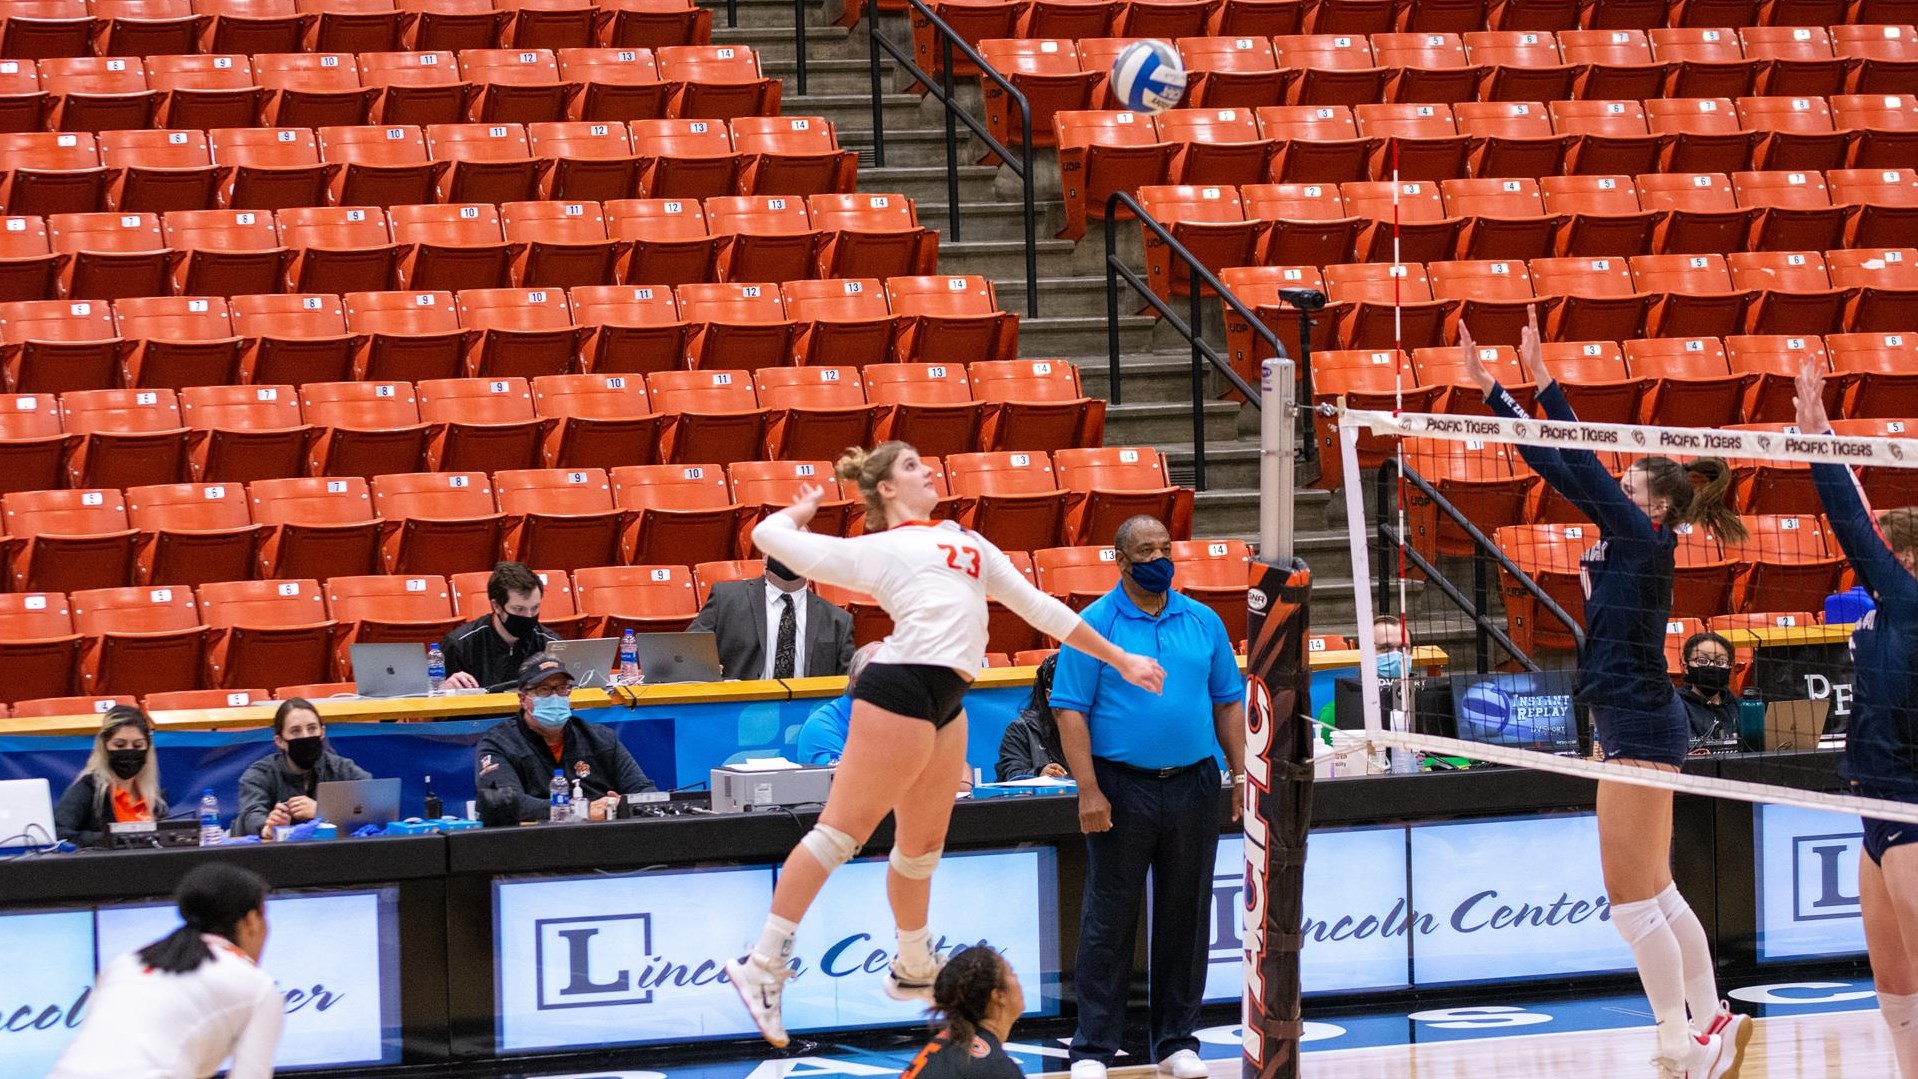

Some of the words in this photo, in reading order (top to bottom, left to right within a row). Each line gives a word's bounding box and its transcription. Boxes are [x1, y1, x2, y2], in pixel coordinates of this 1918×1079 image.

[524, 53, 533, 62] 12
[623, 52, 632, 60] 13
[721, 49, 730, 58] 14
[325, 57, 335, 65] 10
[424, 55, 433, 64] 11
[694, 122, 704, 131] 13
[795, 120, 805, 129] 14
[391, 129, 400, 138] 10
[494, 127, 503, 136] 11
[594, 126, 604, 135] 12
[772, 200, 782, 209] 13
[874, 197, 884, 206] 14
[570, 205, 579, 214] 11
[668, 203, 678, 212] 12
[464, 208, 474, 217] 10
[848, 283, 859, 292] 13
[952, 280, 962, 289] 14
[639, 290, 649, 299] 11
[746, 287, 757, 296] 12
[532, 293, 542, 302] 10
[825, 370, 835, 380] 12
[932, 368, 943, 377] 13
[610, 379, 621, 388] 10
[718, 374, 727, 384] 11
[1426, 418, 1462, 432] PACIFIC
[1464, 419, 1500, 435] TIGERS
[1540, 424, 1578, 440] PACIFIC
[1580, 426, 1618, 443] TIGERS
[1660, 432, 1700, 448] PACIFIC
[1703, 434, 1742, 450] TIGERS
[1785, 438, 1829, 455] PACIFIC
[1832, 441, 1873, 457] TIGERS
[689, 469, 699, 478] 10
[800, 465, 810, 475] 11
[1213, 544, 1224, 553] 14
[1104, 550, 1114, 559] 13
[937, 544, 980, 579] 23
[1310, 639, 1321, 649] 14
[1513, 694, 1569, 707] INSTANT
[1517, 707, 1568, 721] REPLAY
